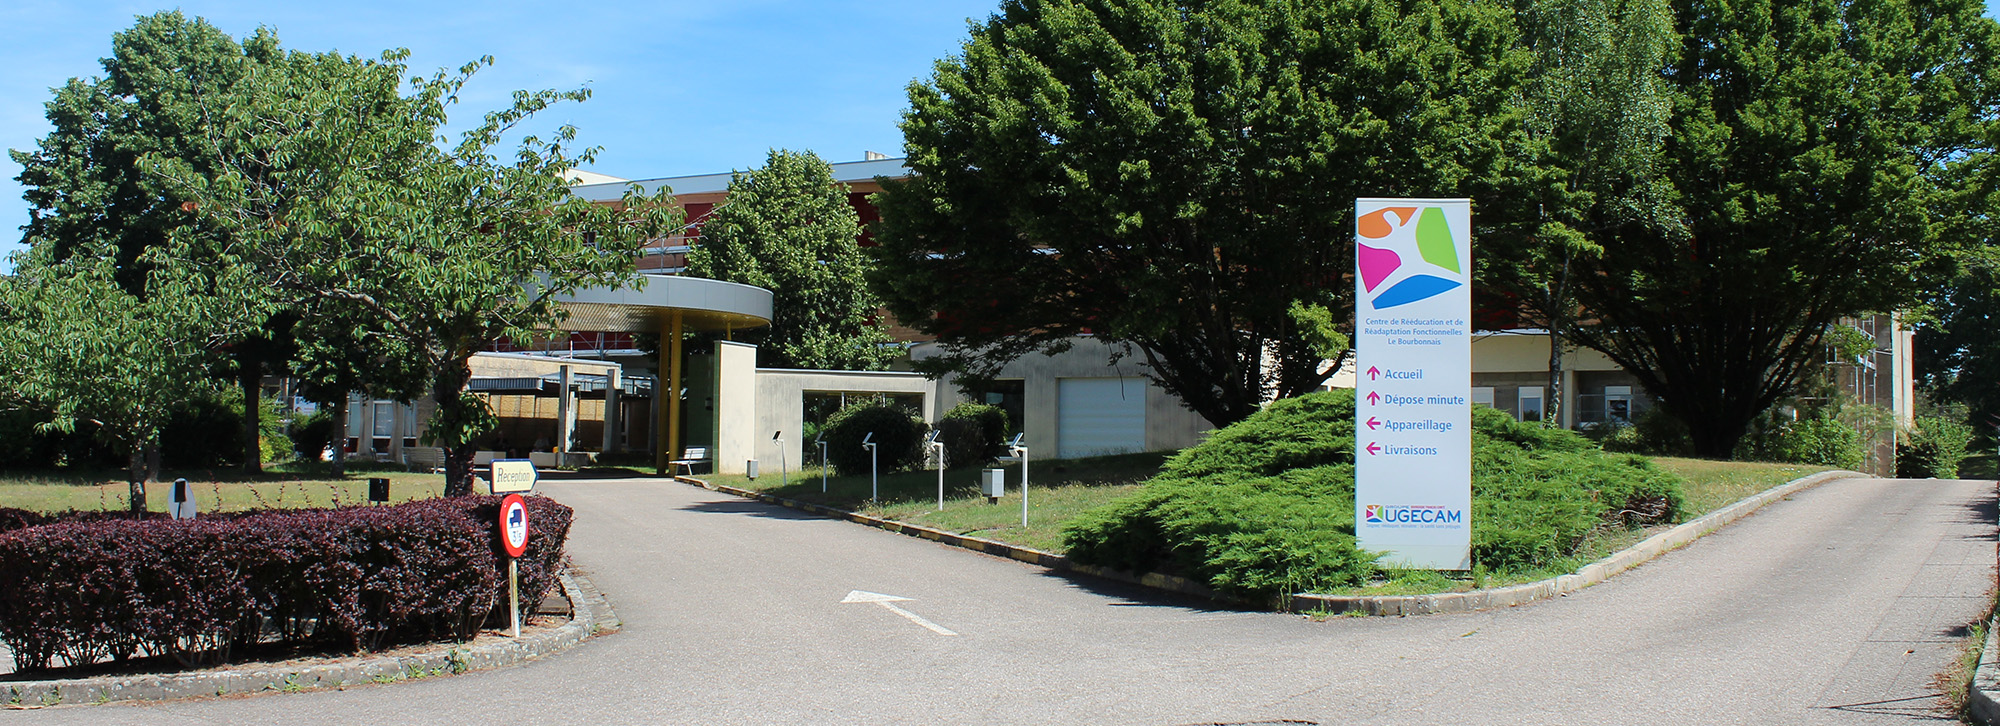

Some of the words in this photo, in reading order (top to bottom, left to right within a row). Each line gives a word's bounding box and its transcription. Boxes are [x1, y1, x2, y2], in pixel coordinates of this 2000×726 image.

[1401, 318, 1444, 326] Rééducation
[1454, 318, 1464, 326] de
[1364, 328, 1411, 336] Réadaptation
[1413, 328, 1462, 336] Fonctionnelles
[1384, 369, 1423, 379] Accueil
[1385, 394, 1424, 406] Dépose
[1427, 395, 1464, 405] minute
[1384, 420, 1452, 432] Appareillage
[1385, 445, 1437, 455] Livraisons
[1385, 509, 1461, 523] UGECAM
